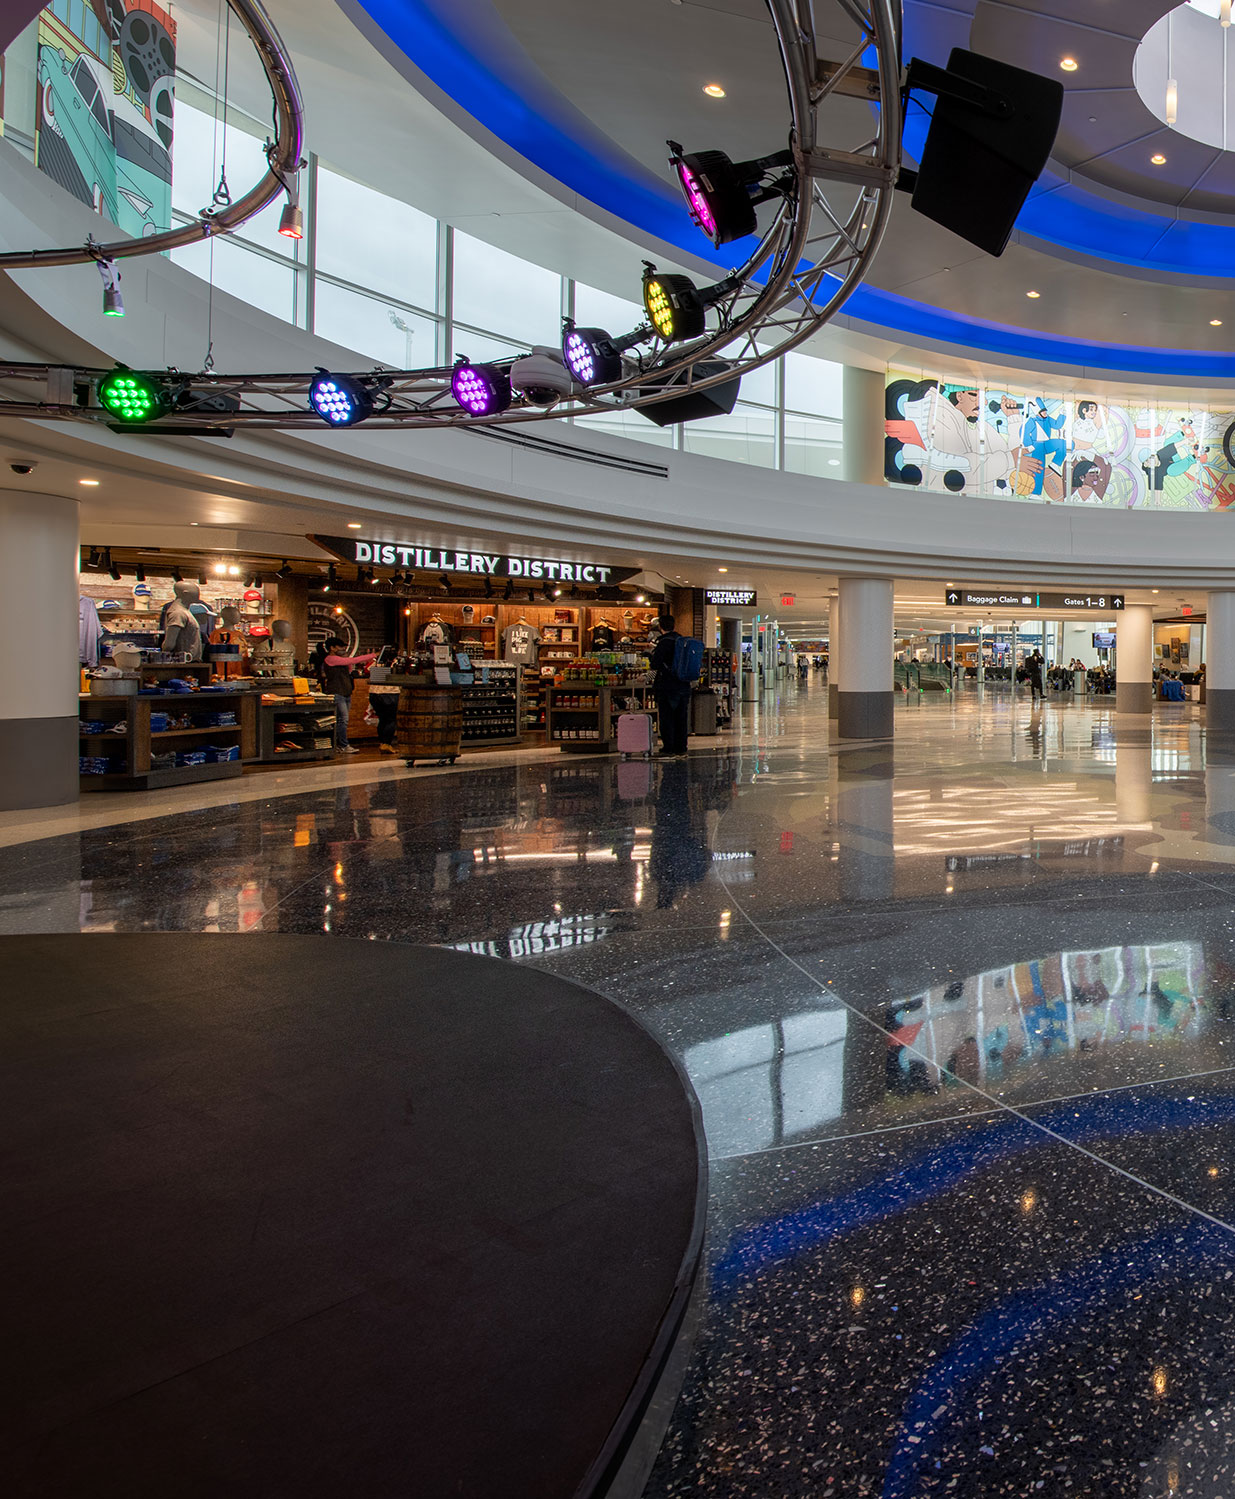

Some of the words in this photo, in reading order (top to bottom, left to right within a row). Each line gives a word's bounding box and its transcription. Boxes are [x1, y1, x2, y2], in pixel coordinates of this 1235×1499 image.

[355, 541, 501, 574] DISTILLERY
[508, 558, 611, 584] DISTRICT
[706, 591, 755, 599] DISTILLERY
[967, 595, 998, 604] Baggage
[999, 595, 1019, 604] Claim
[1064, 598, 1085, 606] Gates
